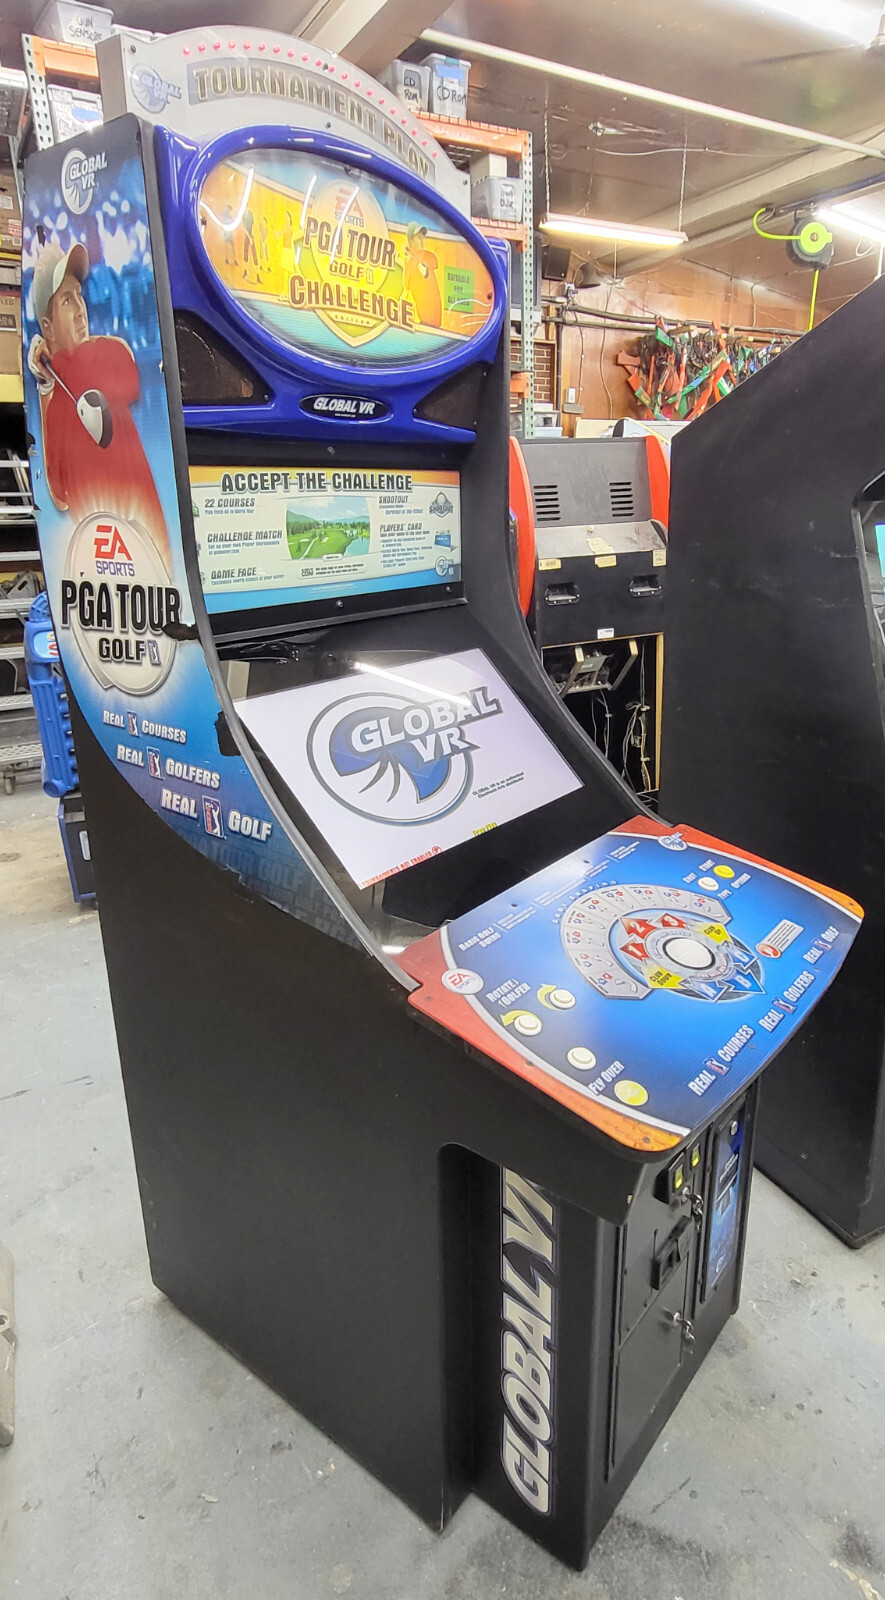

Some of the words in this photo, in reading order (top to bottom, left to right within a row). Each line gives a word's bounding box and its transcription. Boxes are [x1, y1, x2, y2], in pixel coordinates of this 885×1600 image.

[404, 76, 416, 87] CD
[193, 65, 378, 135] TOURNAMENT
[381, 118, 430, 177] PLAY
[70, 152, 108, 180] GLOBAL
[82, 173, 96, 190] VR
[305, 217, 343, 256] PGA
[348, 229, 395, 268] TOUR
[330, 260, 364, 279] GOLF
[290, 275, 414, 329] CHALLENGE
[313, 396, 357, 413] GLOBAL
[358, 401, 376, 415] VR
[221, 472, 290, 493] ACCEPT
[296, 472, 327, 490] THE
[332, 473, 412, 491] CHALLENGE
[204, 499, 215, 508] 22
[217, 498, 255, 508] COURSES
[379, 495, 408, 504] SHOOTOUT
[94, 525, 132, 561] EA
[207, 531, 253, 543] CHALLENGE
[255, 530, 282, 540] MATCH
[96, 560, 135, 577] SPORTS
[211, 569, 235, 580] GAME
[238, 567, 257, 577] FACE
[61, 579, 113, 630] PGA
[116, 583, 181, 632] TOUR
[99, 637, 146, 662] GOLF
[103, 710, 125, 728] REAL
[141, 719, 187, 744] COURSES
[351, 688, 499, 753] GLOBAL
[409, 726, 471, 764] VR
[117, 744, 145, 767] REAL
[165, 757, 220, 789] GOLFERS
[161, 788, 199, 819] REAL
[228, 809, 273, 842] GOLF
[630, 920, 646, 933] 2
[664, 914, 678, 926] 3
[703, 925, 716, 936] CLUB
[628, 945, 643, 957] 1
[803, 946, 824, 964] REAL
[821, 925, 840, 943] GOLF
[449, 973, 471, 987] EA
[649, 970, 663, 983] CLUB
[656, 972, 673, 986] DOWN
[735, 976, 752, 989] B
[700, 983, 717, 998] A
[758, 1009, 785, 1032] REAL
[783, 970, 816, 1002] GOLFERS
[688, 1069, 717, 1096] REAL
[717, 1024, 755, 1062] COURSES
[588, 1077, 606, 1095] FLY
[600, 1060, 625, 1083] OVER
[502, 1262, 554, 1515] GLOBAL
